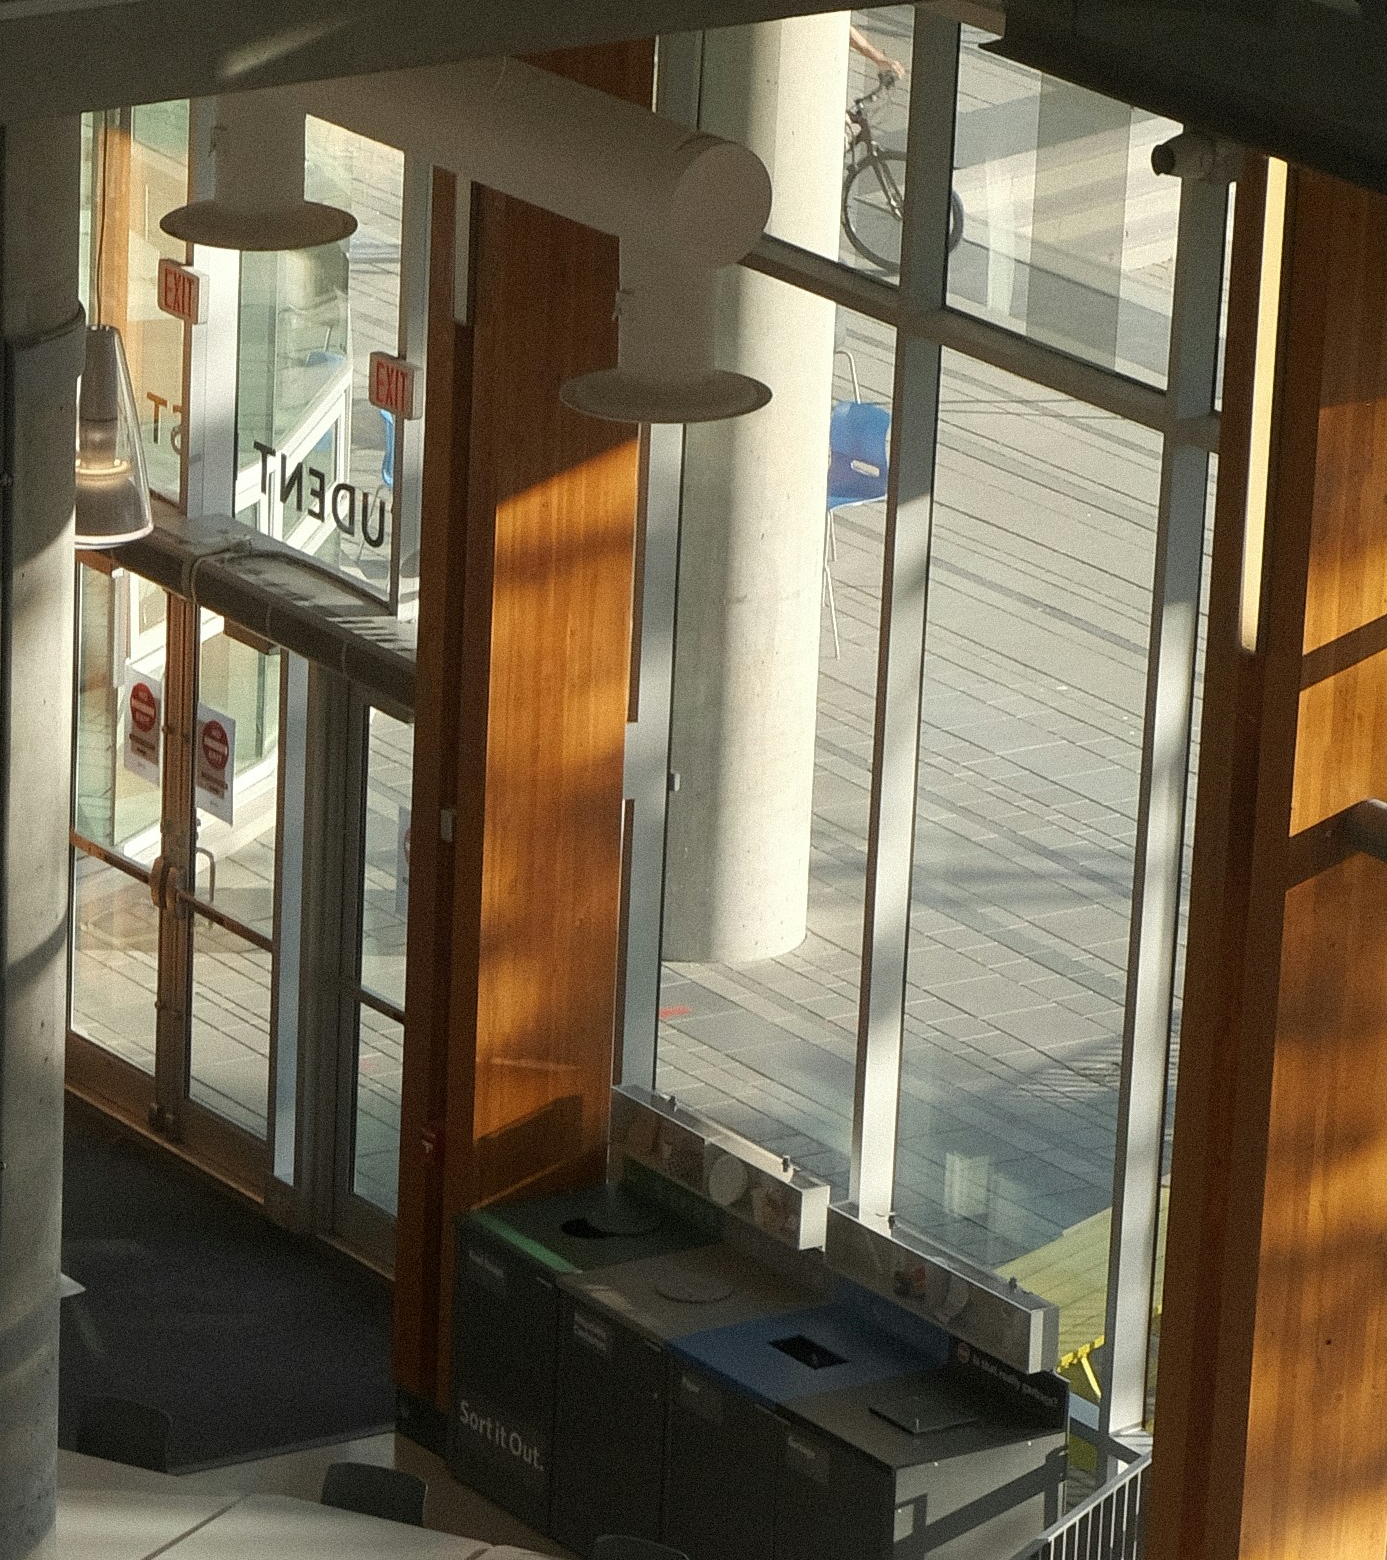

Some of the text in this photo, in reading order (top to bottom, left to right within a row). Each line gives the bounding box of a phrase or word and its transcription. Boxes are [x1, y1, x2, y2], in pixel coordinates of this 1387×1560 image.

[164, 267, 193, 319] EXIT
[376, 359, 407, 411] EXIT
[459, 1399, 493, 1440] Sort
[508, 1432, 545, 1471] Out.
